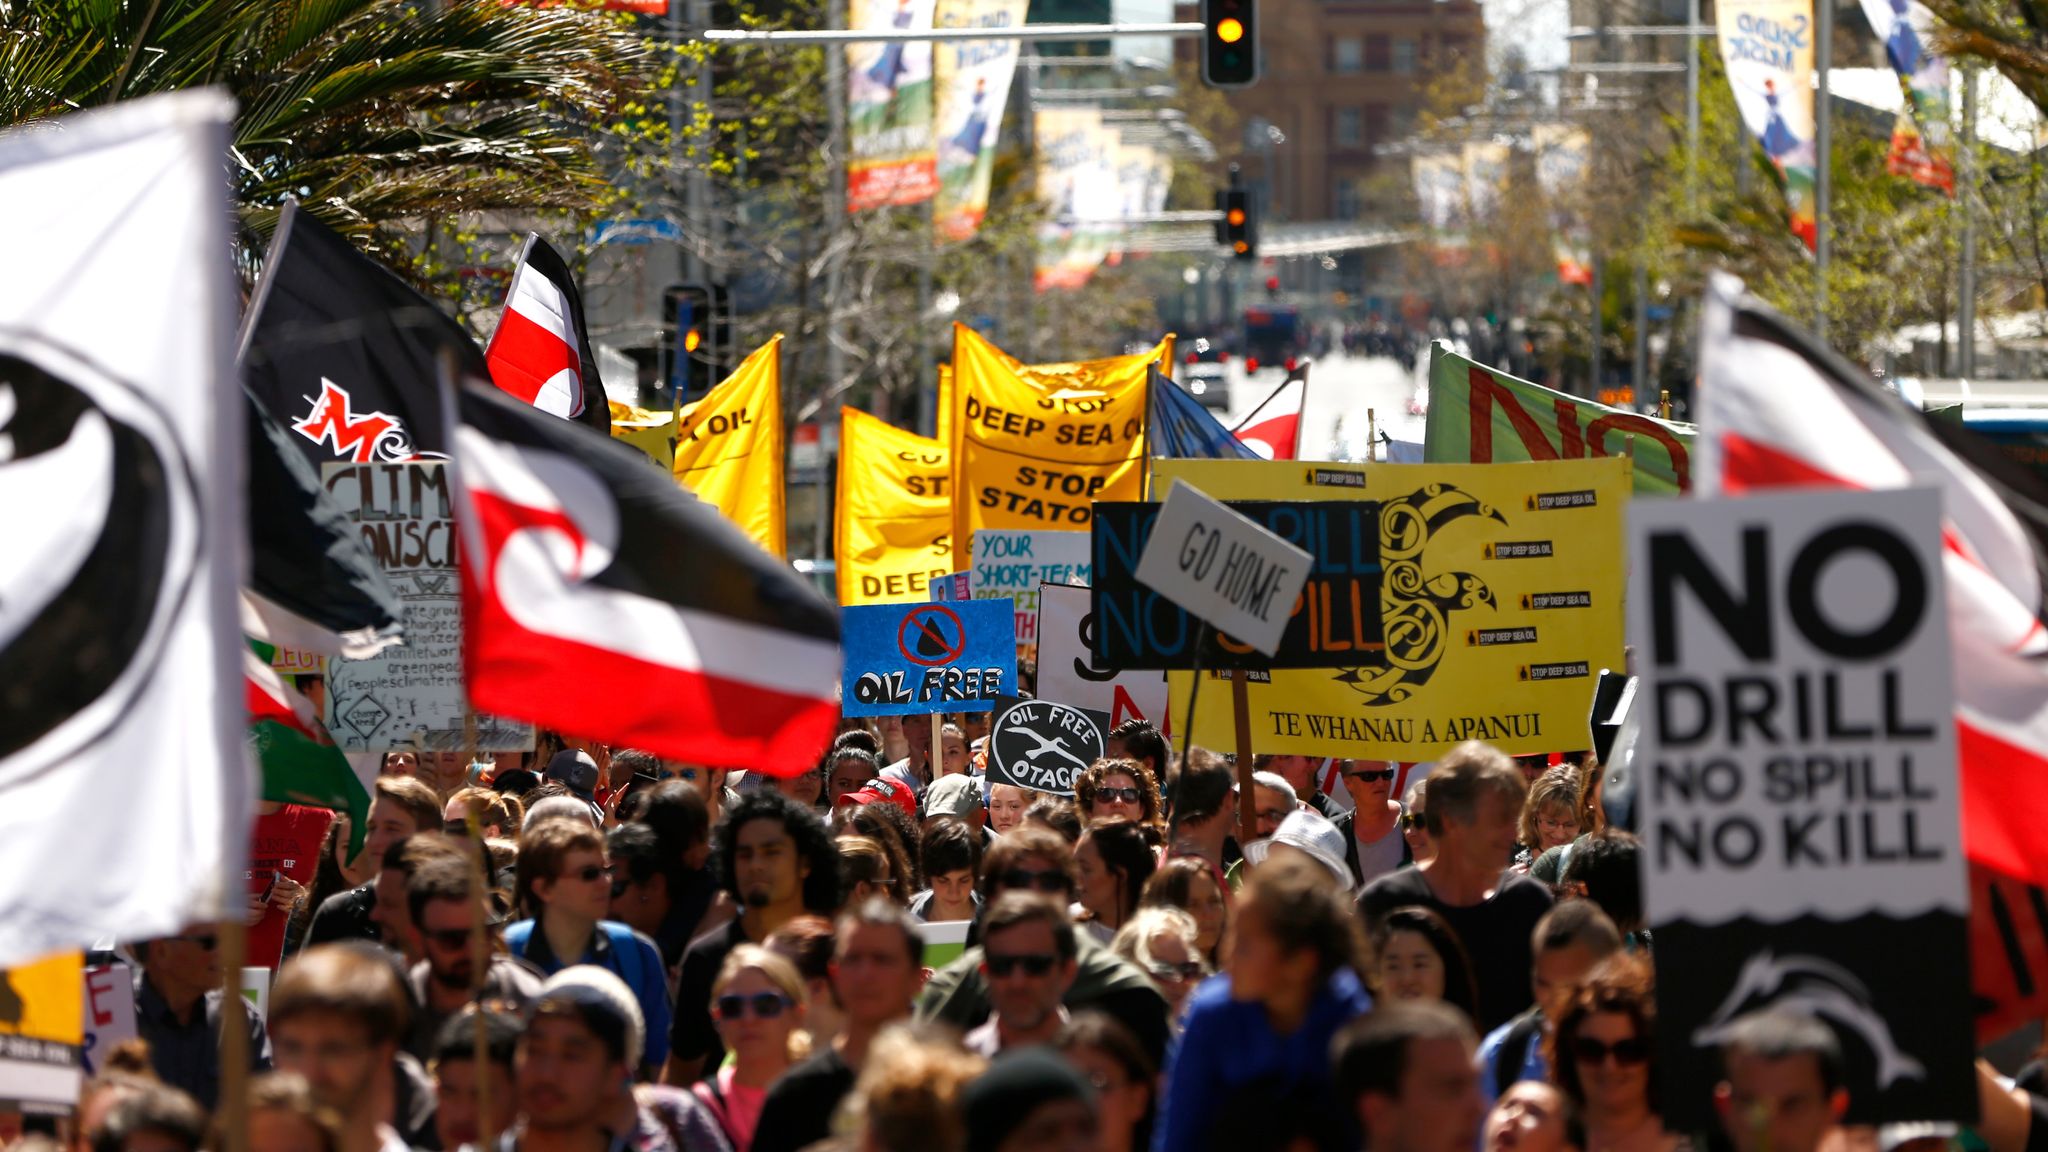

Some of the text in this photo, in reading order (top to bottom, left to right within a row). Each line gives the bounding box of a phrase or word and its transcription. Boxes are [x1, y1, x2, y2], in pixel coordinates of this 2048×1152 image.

[965, 393, 1046, 438] DEEP
[1054, 422, 1114, 446] SEA
[325, 463, 454, 523] CLIM
[906, 475, 949, 496] ST
[1015, 466, 1106, 498] STOP
[1538, 496, 1554, 507] STOP
[979, 486, 1092, 524] STATO
[360, 520, 460, 571] ONSCI
[981, 534, 1034, 559] YOUR
[1541, 544, 1552, 554] OIL
[1179, 521, 1290, 623] GO HOME
[1534, 596, 1550, 607] STOP
[1647, 517, 1928, 668] NO
[1099, 590, 1189, 661] NO
[1480, 632, 1496, 643] STOP
[854, 665, 1004, 705] OIL FREE
[1532, 664, 1588, 678] STOP DEEP SEA OIL
[1009, 705, 1039, 726] OIL
[1048, 706, 1096, 745] FREE
[1269, 711, 1542, 744] TE WHANAU A APANUI
[1655, 668, 1936, 750] DRILL
[1655, 752, 1937, 808] NO SPILL
[1657, 809, 1942, 873] NO KILL
[284, 859, 296, 868] OF
